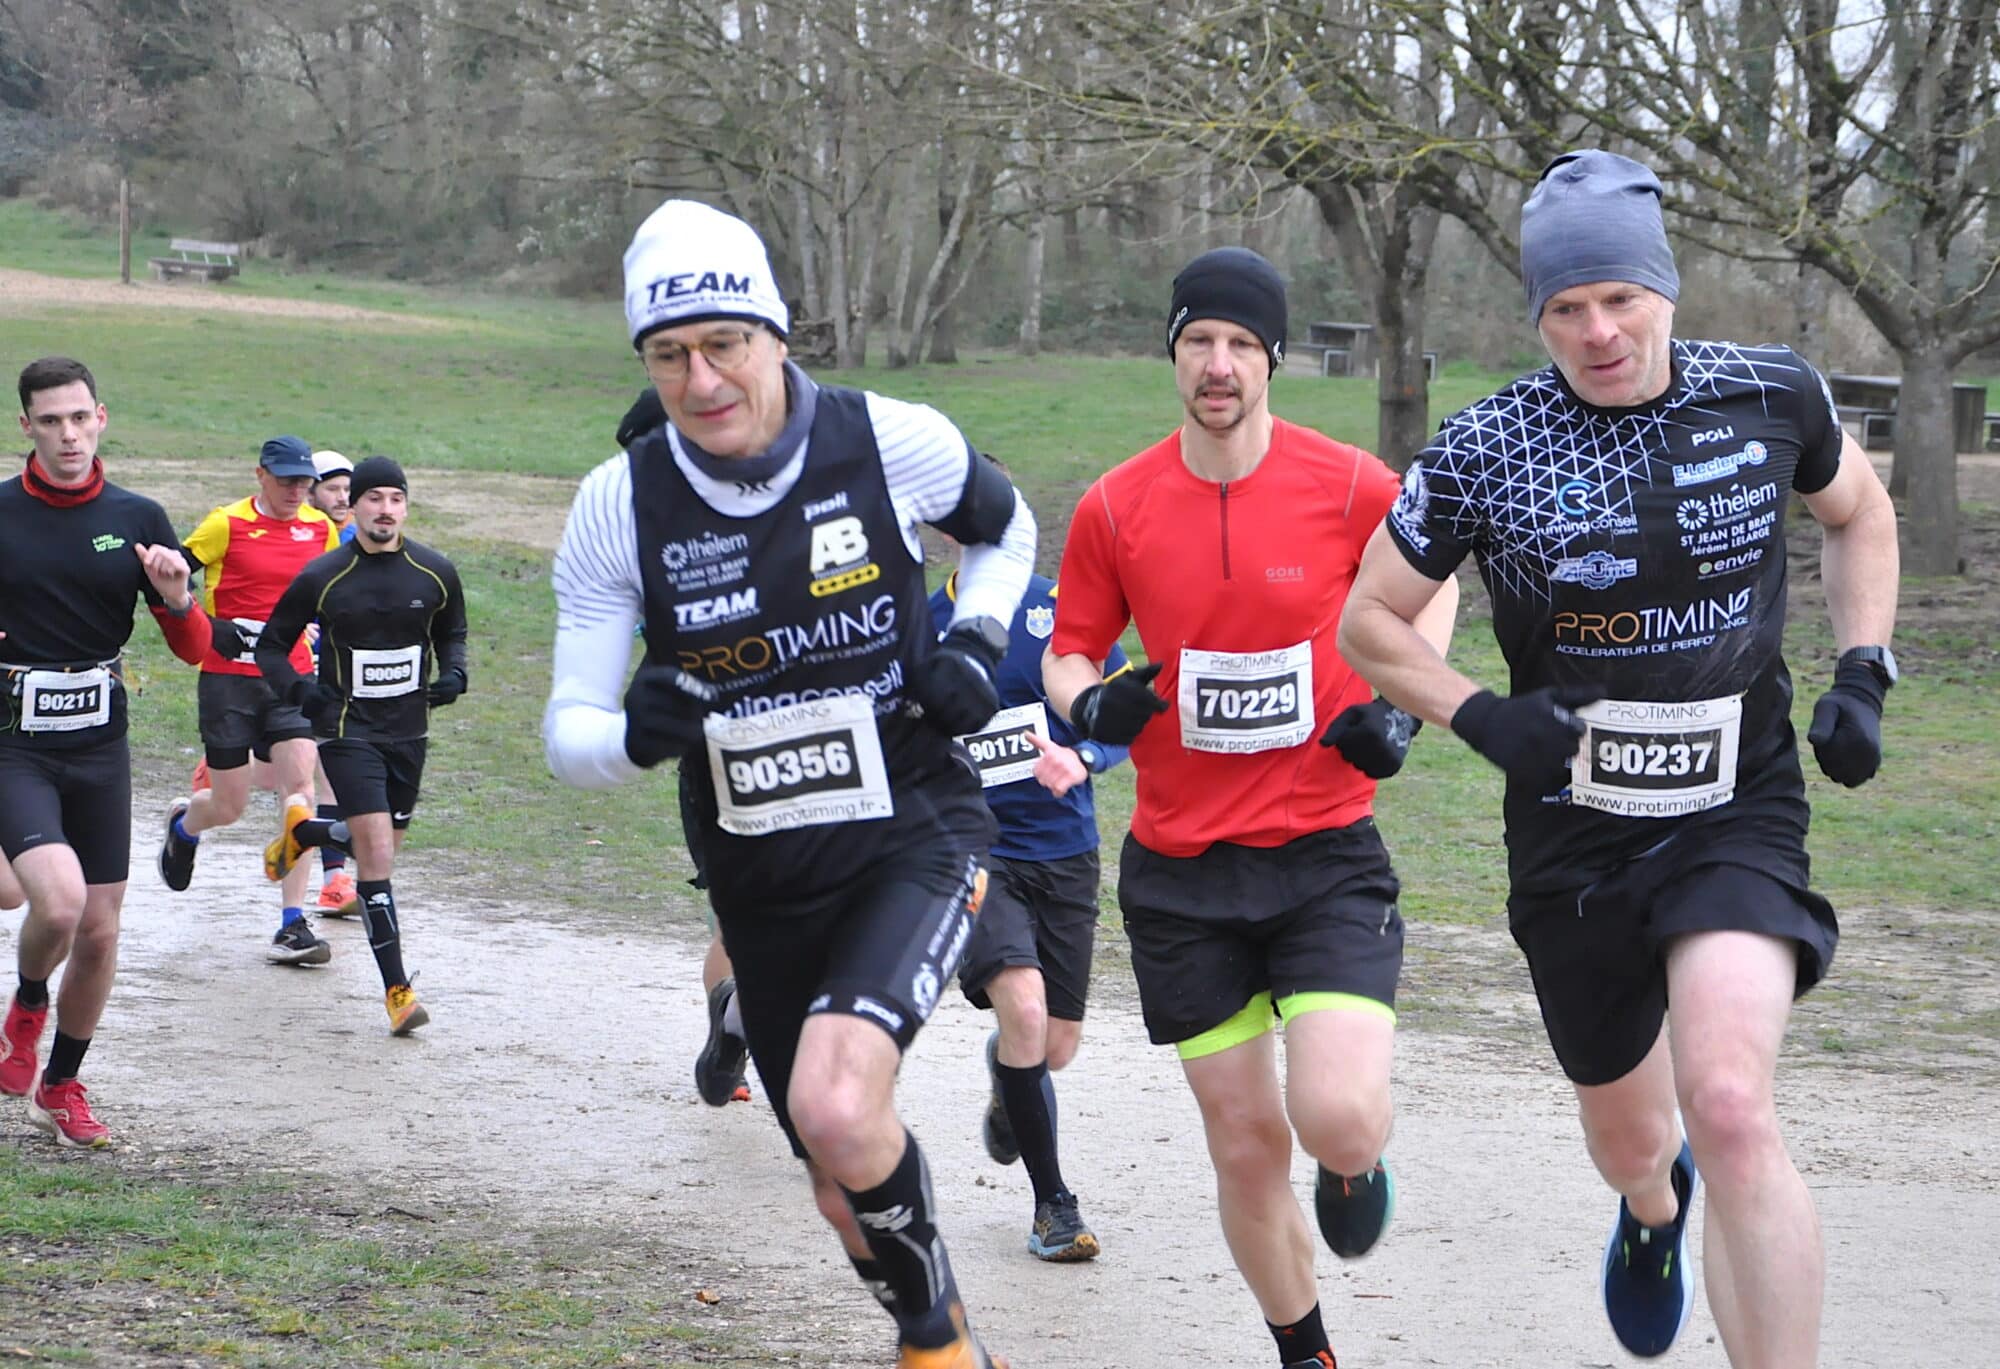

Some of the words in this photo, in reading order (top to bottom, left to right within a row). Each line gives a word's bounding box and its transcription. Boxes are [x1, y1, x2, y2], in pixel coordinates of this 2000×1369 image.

[646, 271, 750, 304] TEAM
[1691, 425, 1735, 447] POLI
[1709, 482, 1777, 518] thélem
[1680, 534, 1694, 547] ST
[1697, 528, 1728, 545] JEAN
[1731, 523, 1745, 537] DE
[1747, 511, 1777, 530] BRAYE
[1690, 542, 1729, 557] Jérôme
[1731, 526, 1770, 548] LELARGE
[810, 516, 869, 574] AB
[1714, 548, 1763, 571] envie
[1265, 566, 1304, 578] GORE
[673, 587, 757, 626] TEAM
[677, 595, 896, 680] PROTIMING
[1555, 644, 1648, 658] ACCELERATEUR
[1651, 643, 1668, 653] DE
[365, 664, 411, 681] 90069
[1210, 651, 1288, 668] PROTIMING
[38, 690, 96, 711] 90211
[1200, 682, 1296, 719] 70229
[1608, 703, 1708, 720] PROTIMING
[728, 702, 833, 739] PROTIMING
[1191, 730, 1306, 752] www.protiming.fr
[729, 741, 852, 794] 90356
[1598, 741, 1714, 776] 90237
[731, 800, 876, 831] www.protiming.fr
[1584, 792, 1728, 815] www.protiming.fr
